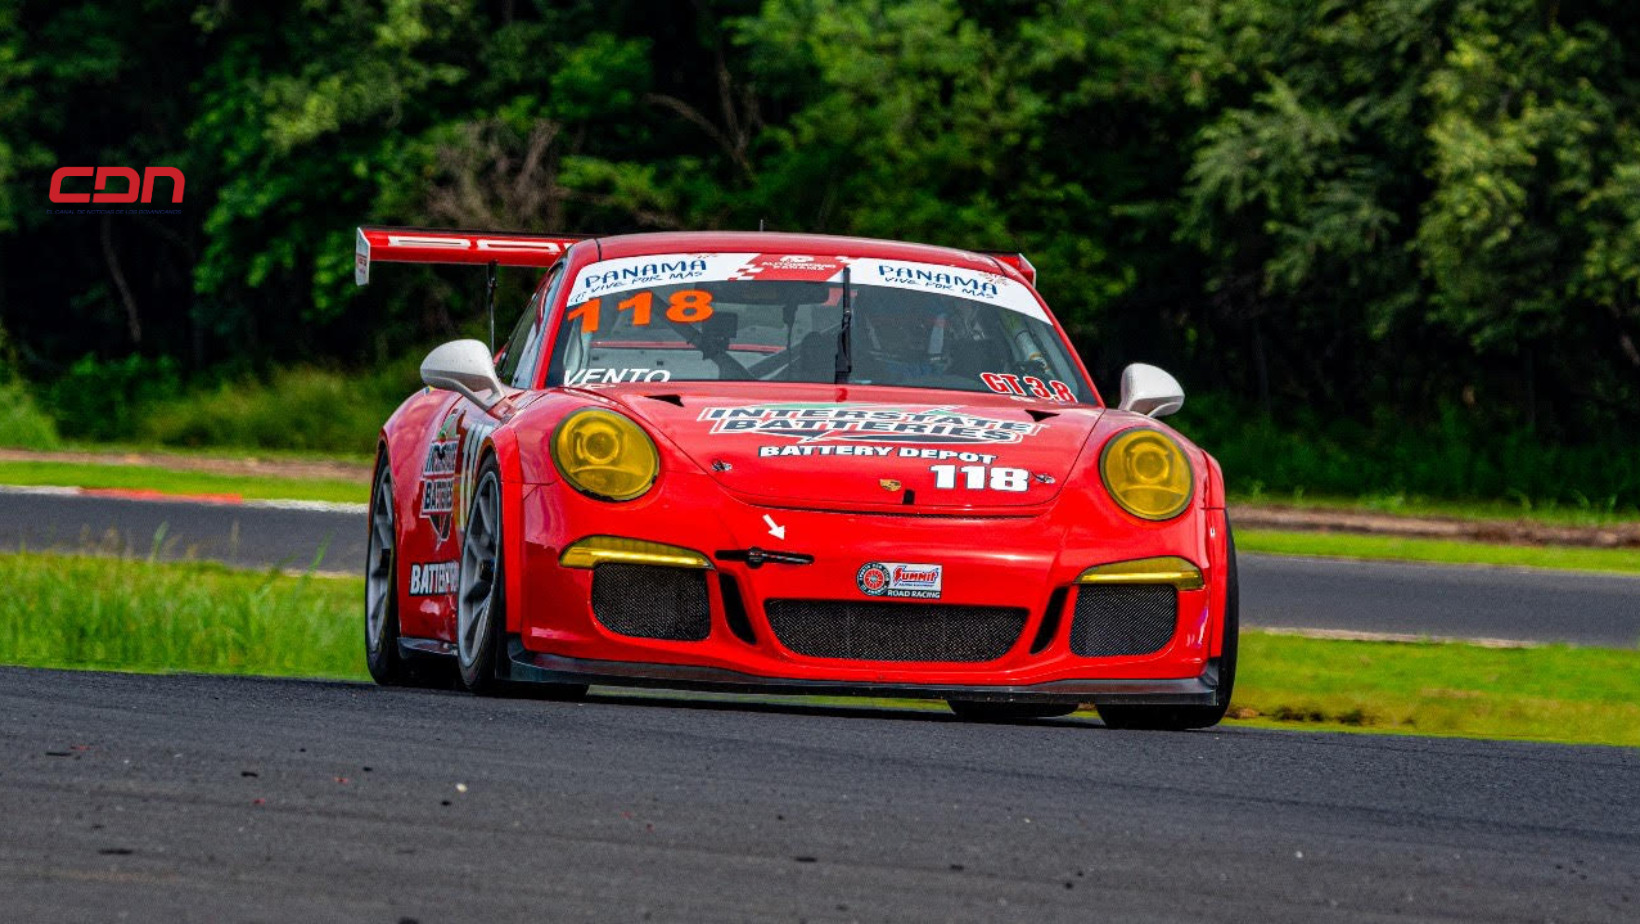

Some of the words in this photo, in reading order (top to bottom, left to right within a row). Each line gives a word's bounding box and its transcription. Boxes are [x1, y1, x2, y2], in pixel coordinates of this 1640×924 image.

[585, 260, 707, 288] PANAMA
[878, 265, 998, 295] PANAMA
[885, 276, 920, 285] VIVE
[591, 281, 624, 293] VIVE
[567, 289, 714, 334] 118
[563, 368, 671, 387] VENTO
[980, 372, 1027, 396] GT
[700, 407, 1042, 434] INTERSTATE
[711, 419, 1024, 443] BATTERIES
[758, 445, 895, 458] BATTERY
[897, 447, 998, 464] DEPOT
[929, 464, 1030, 492] 118
[888, 589, 910, 597] ROAD
[911, 590, 940, 599] RACING
